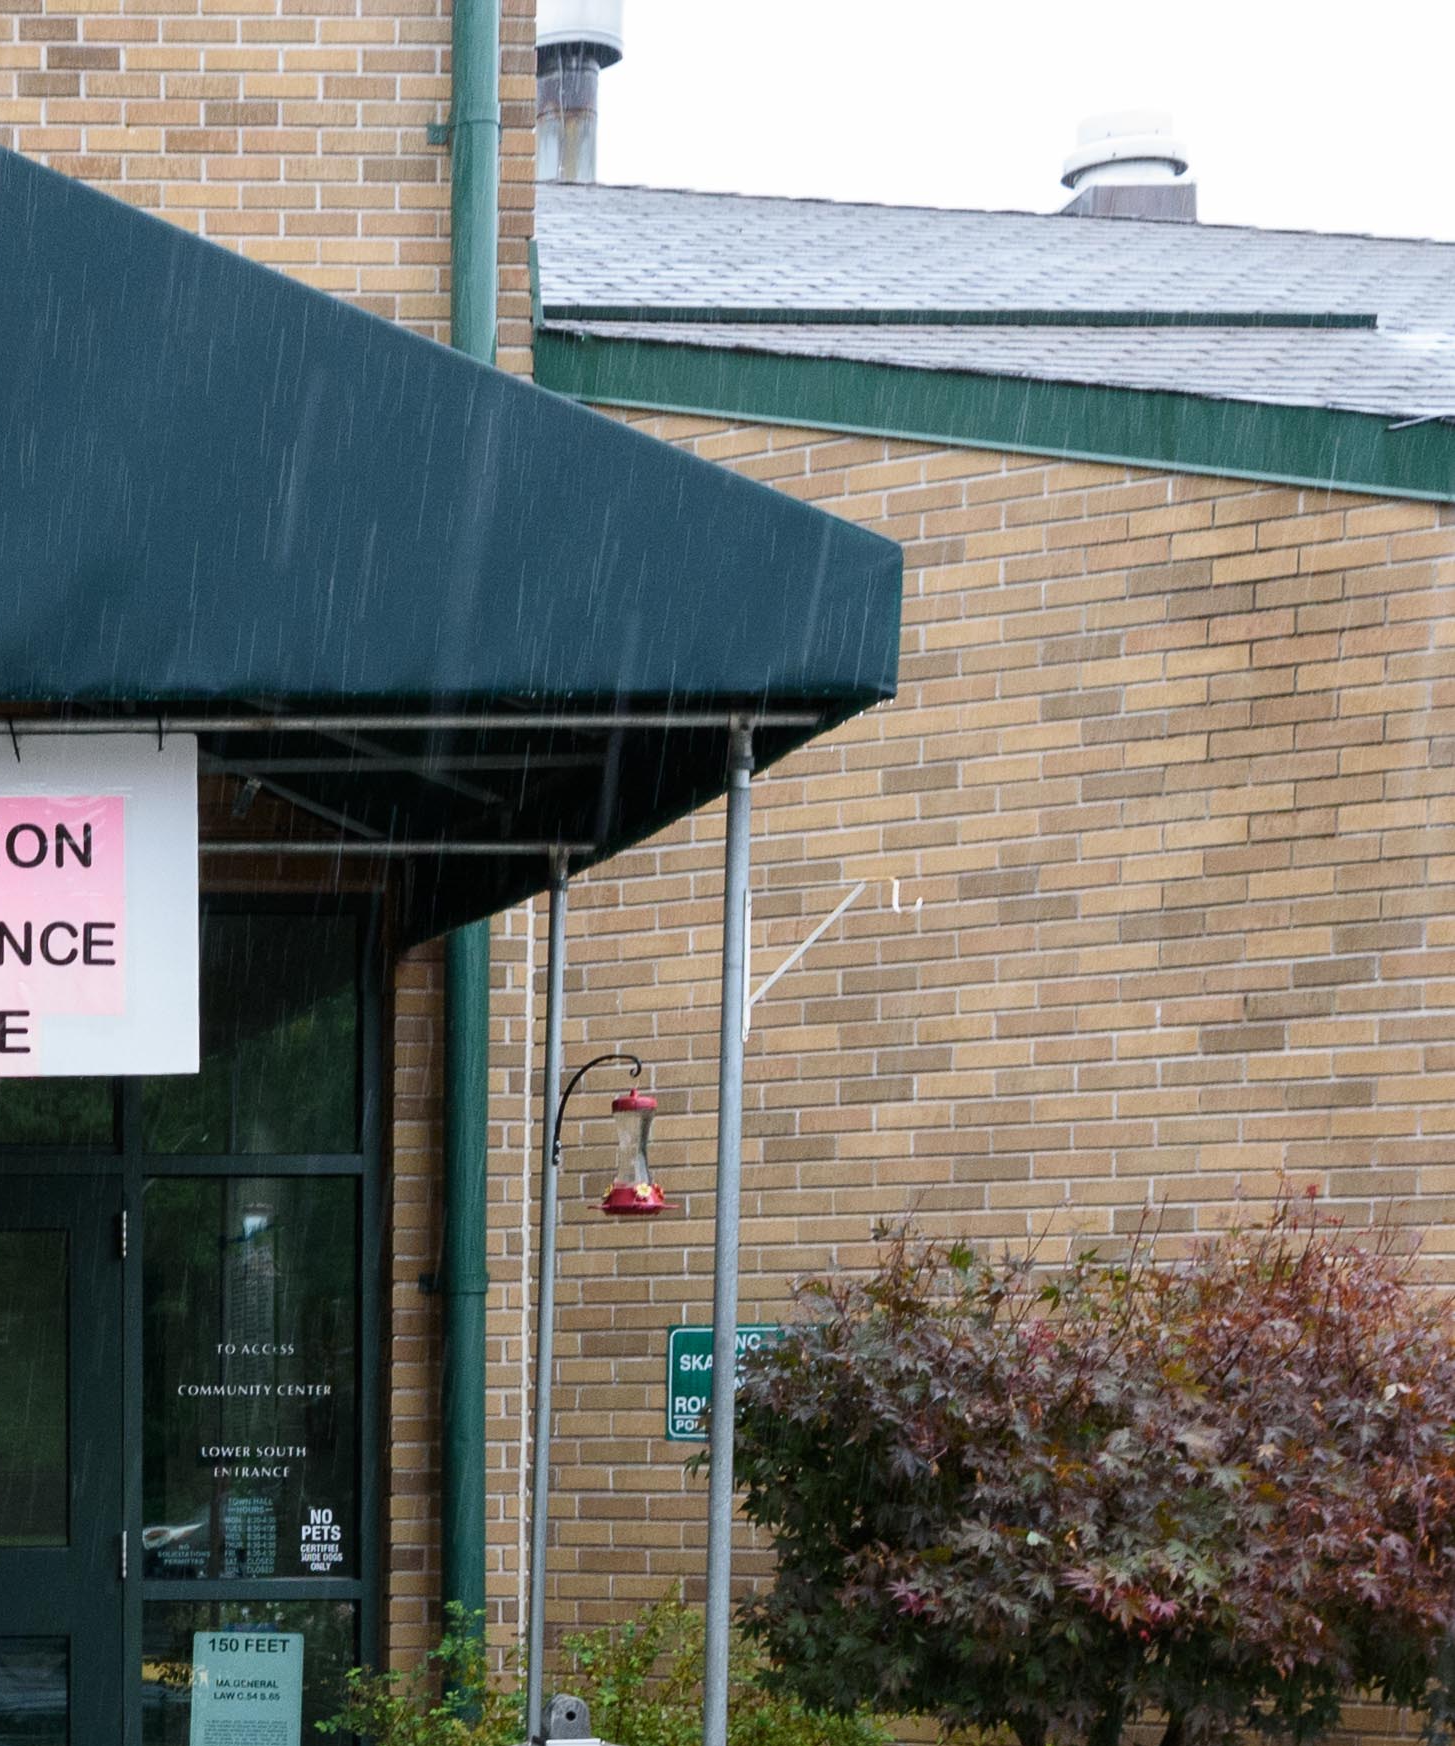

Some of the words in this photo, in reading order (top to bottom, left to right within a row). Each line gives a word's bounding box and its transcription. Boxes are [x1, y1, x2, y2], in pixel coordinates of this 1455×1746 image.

[216, 1343, 236, 1355] TO
[241, 1343, 295, 1355] ACCESS
[177, 1384, 272, 1396] COMMUNITY
[276, 1384, 331, 1396] CENTER
[201, 1446, 251, 1458] LOWER
[255, 1446, 307, 1458] SOUTH
[213, 1466, 291, 1478] ENTRANCE
[310, 1508, 333, 1525] NO
[301, 1525, 341, 1541] PETS
[322, 1552, 343, 1562] DOGS
[310, 1562, 331, 1571] ONLY
[208, 1638, 239, 1653] 150
[244, 1638, 290, 1653] FEET
[213, 1692, 235, 1701] LAW
